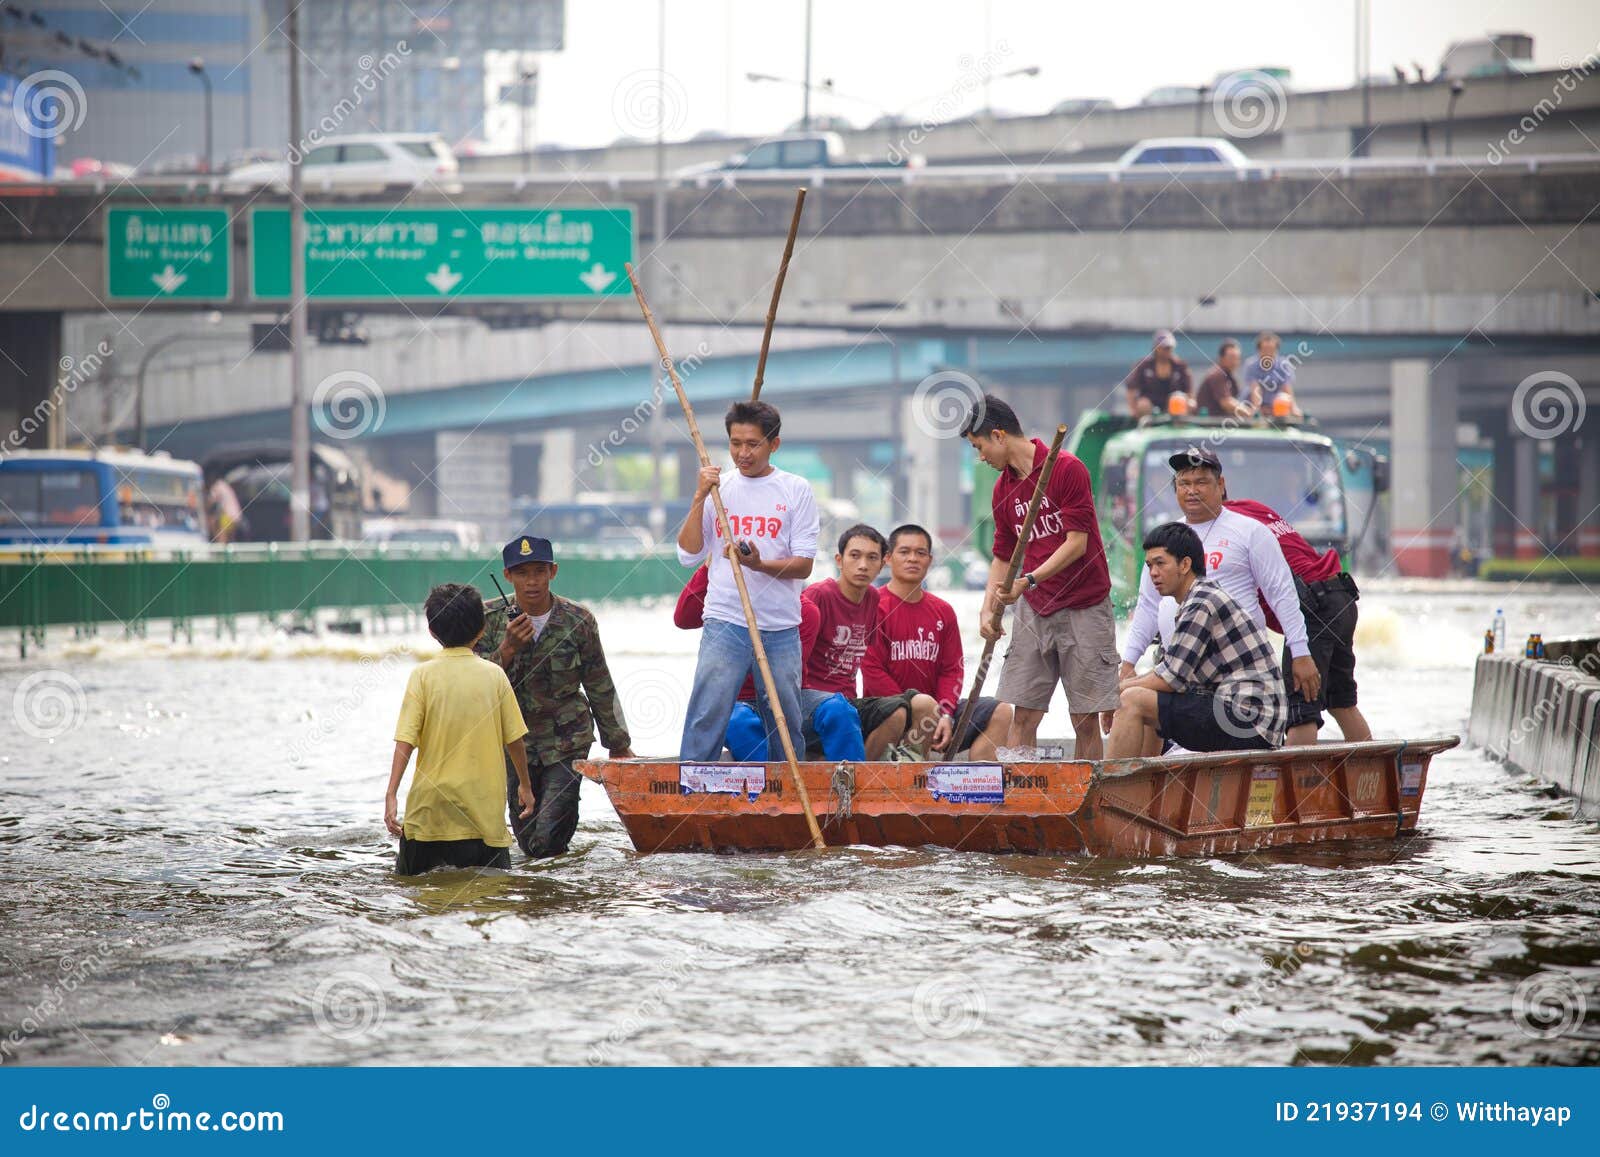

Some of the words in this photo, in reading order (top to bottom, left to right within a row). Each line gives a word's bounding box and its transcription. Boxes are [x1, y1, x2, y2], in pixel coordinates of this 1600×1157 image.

[302, 222, 438, 245] ะพานควาย
[1015, 496, 1050, 517] ตำจ
